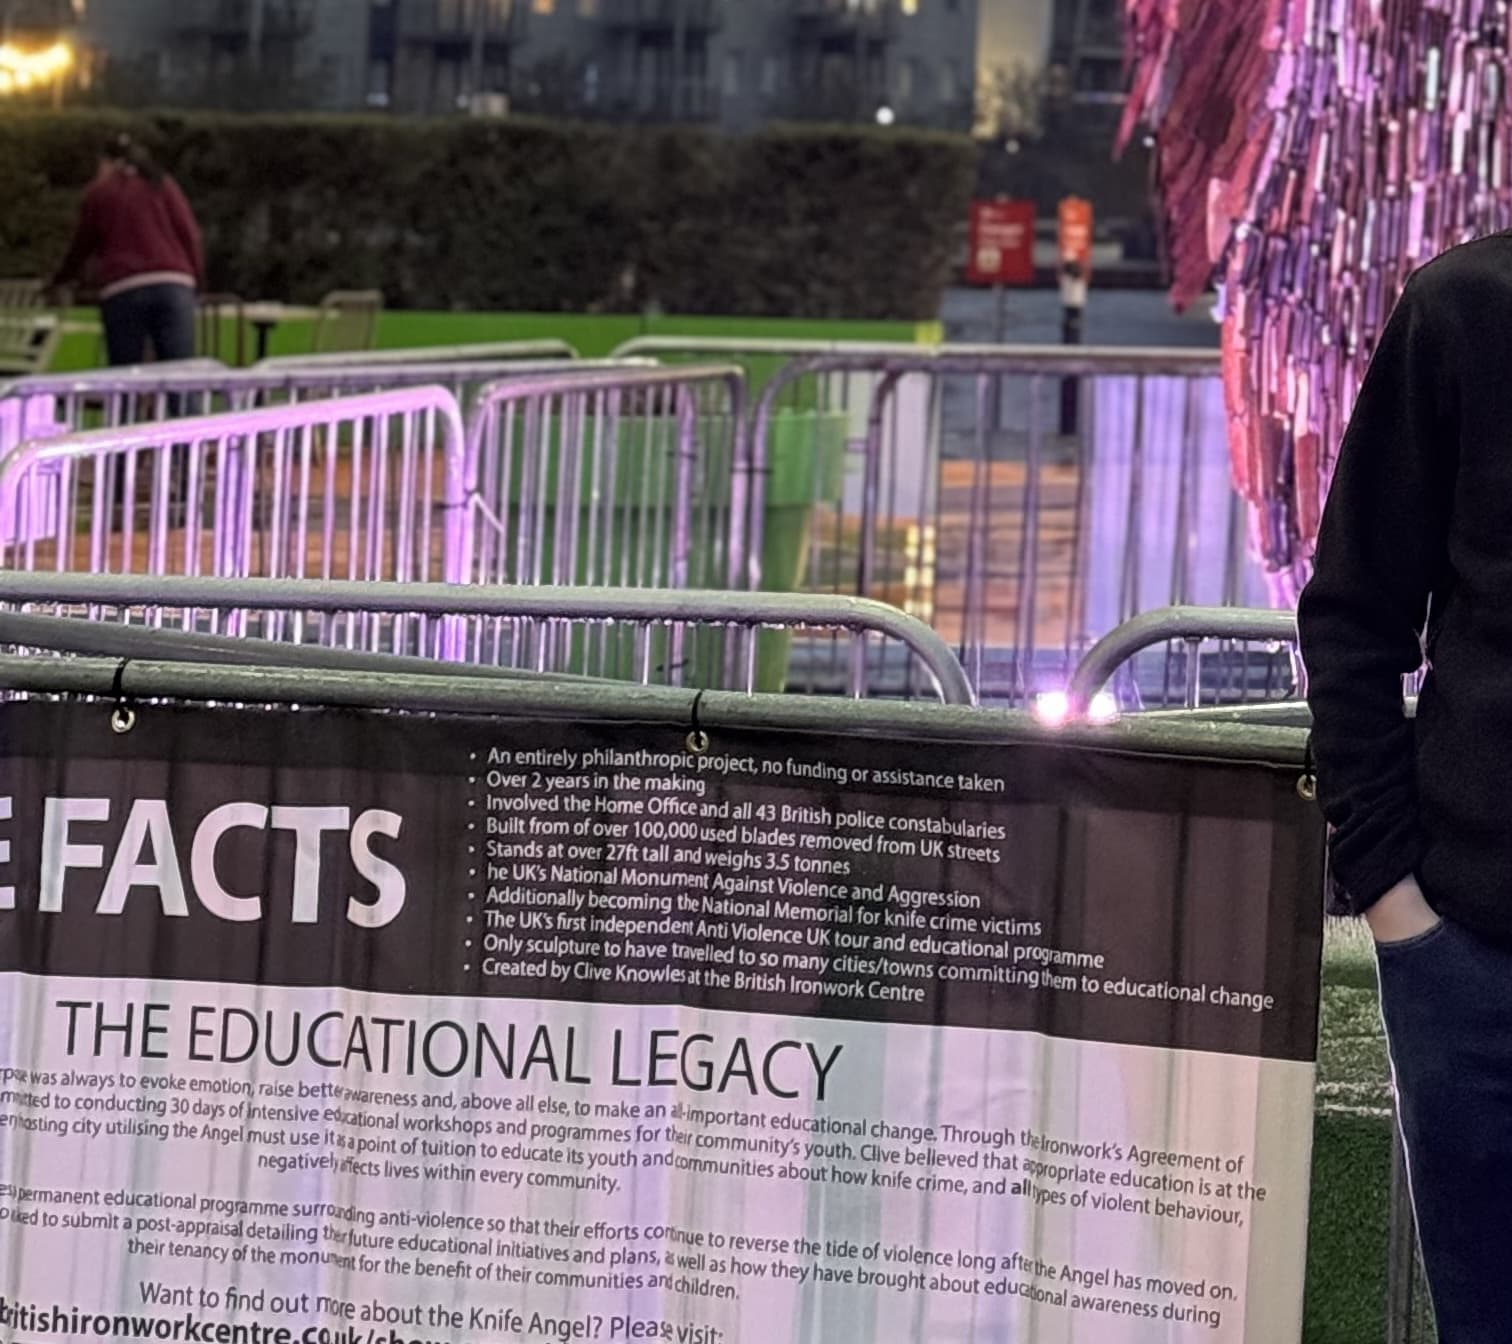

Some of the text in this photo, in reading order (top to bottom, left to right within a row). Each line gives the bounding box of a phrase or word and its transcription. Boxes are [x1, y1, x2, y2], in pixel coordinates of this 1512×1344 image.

[487, 770, 705, 796] Over 2 years in the making
[488, 746, 1004, 792] An entirely philanthropic project, no funding or assistance taken
[487, 793, 1005, 839] Involved the Home Office and all 43 British police constabularies
[487, 816, 1000, 862] Built from of over 100,000 used blades removed from UK streets
[38, 797, 407, 929] FACTS
[487, 839, 850, 874] Stands at over 27ft tall and weighs 3.5 tonnes
[487, 884, 1041, 936] Additionally becoming the National Memorial for knife crime victims
[488, 862, 980, 909] he UK's National Monument Against Violence and Aggression
[488, 910, 1104, 969] The UK's first independent Anti Violence UK tour and educational programme
[483, 958, 924, 1001] Created by Clive Knowles at the British Ironwork Centre
[484, 934, 1273, 1014] Only sculpture to have travelled to so many cities/towns committing them to educational change
[56, 1000, 843, 1102] THE EDUCATIONAL LEGACY
[30, 1071, 57, 1084] was
[61, 1069, 115, 1091] always
[119, 1072, 136, 1088] to
[140, 1072, 186, 1090] evoke
[189, 1075, 255, 1096] emotion,
[259, 1079, 294, 1096] raise
[422, 1091, 456, 1111] and,
[461, 1092, 512, 1110] above
[516, 1094, 534, 1111] all
[538, 1095, 569, 1116] else,
[575, 1098, 590, 1114] to
[595, 1100, 640, 1117] make
[645, 1105, 666, 1119] an
[770, 1113, 866, 1136] educational
[871, 1121, 937, 1145] change.
[940, 1124, 1015, 1148] Through
[1127, 1144, 1220, 1169] Agreement
[1226, 1154, 1243, 1172] of
[140, 1281, 192, 1307] Want
[199, 1287, 219, 1309] to
[226, 1288, 264, 1312] find
[270, 1293, 309, 1313] out
[316, 1297, 355, 1318] more
[361, 1299, 422, 1324] about
[429, 1304, 463, 1328] the
[470, 1307, 523, 1333] Knife
[528, 1312, 602, 1343] Angel?
